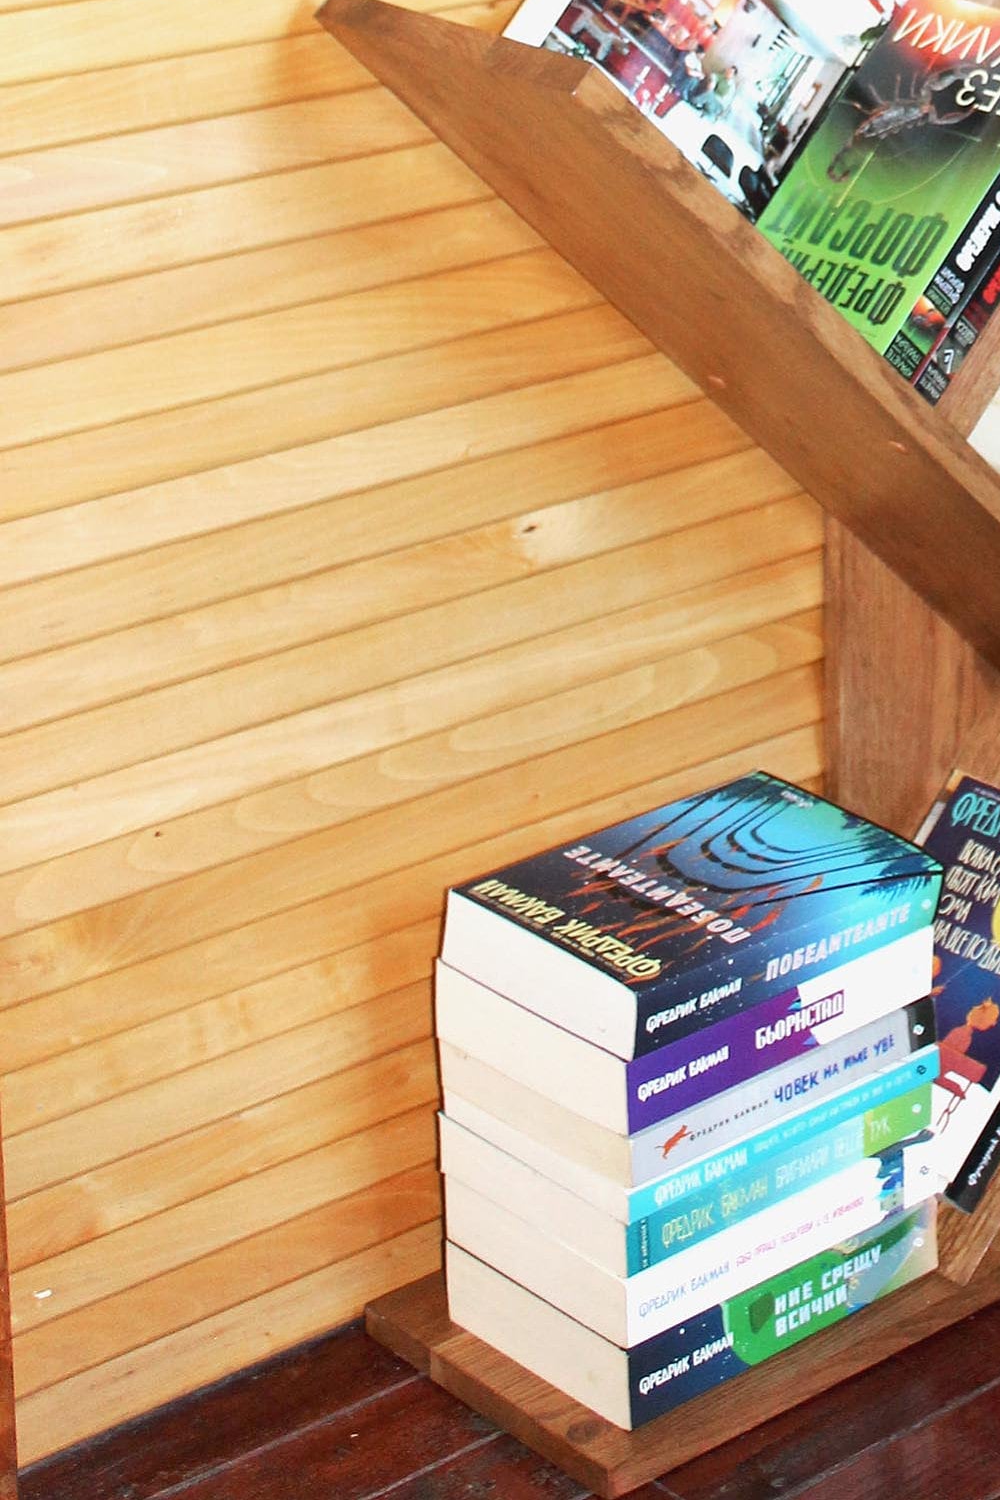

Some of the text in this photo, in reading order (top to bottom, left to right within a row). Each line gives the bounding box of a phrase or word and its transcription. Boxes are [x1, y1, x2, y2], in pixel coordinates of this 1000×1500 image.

[768, 190, 949, 278] ФОРСАЙТ
[562, 844, 752, 945] ПОБЕДИТЕЛИТЕ
[471, 878, 662, 978] ФРЕДРИК БАКМАН
[764, 900, 912, 984] ПОБЕДИТЕЛИТЕ
[646, 975, 743, 1035] ФРЕДРИК БАКМАН
[754, 987, 847, 1051] БЬОРНСТАД
[638, 1043, 729, 1104] ФРЕДРИК БАКМАН
[773, 1068, 818, 1106] ЧОВЕК
[823, 1061, 838, 1081] НА
[872, 1031, 895, 1056] УВЕ
[655, 1169, 698, 1207] ФРЕДРИК
[702, 1147, 748, 1184] БАКМАН
[663, 1202, 714, 1250] ФРЕДРИК
[638, 1259, 729, 1320] ФРЕДРИК БАКМАН
[773, 1242, 882, 1316] НИЕ СРЕЩУ
[774, 1281, 848, 1339] ВСИЧКИ
[640, 1329, 733, 1397] ФРЕДРИК БАКМАН
